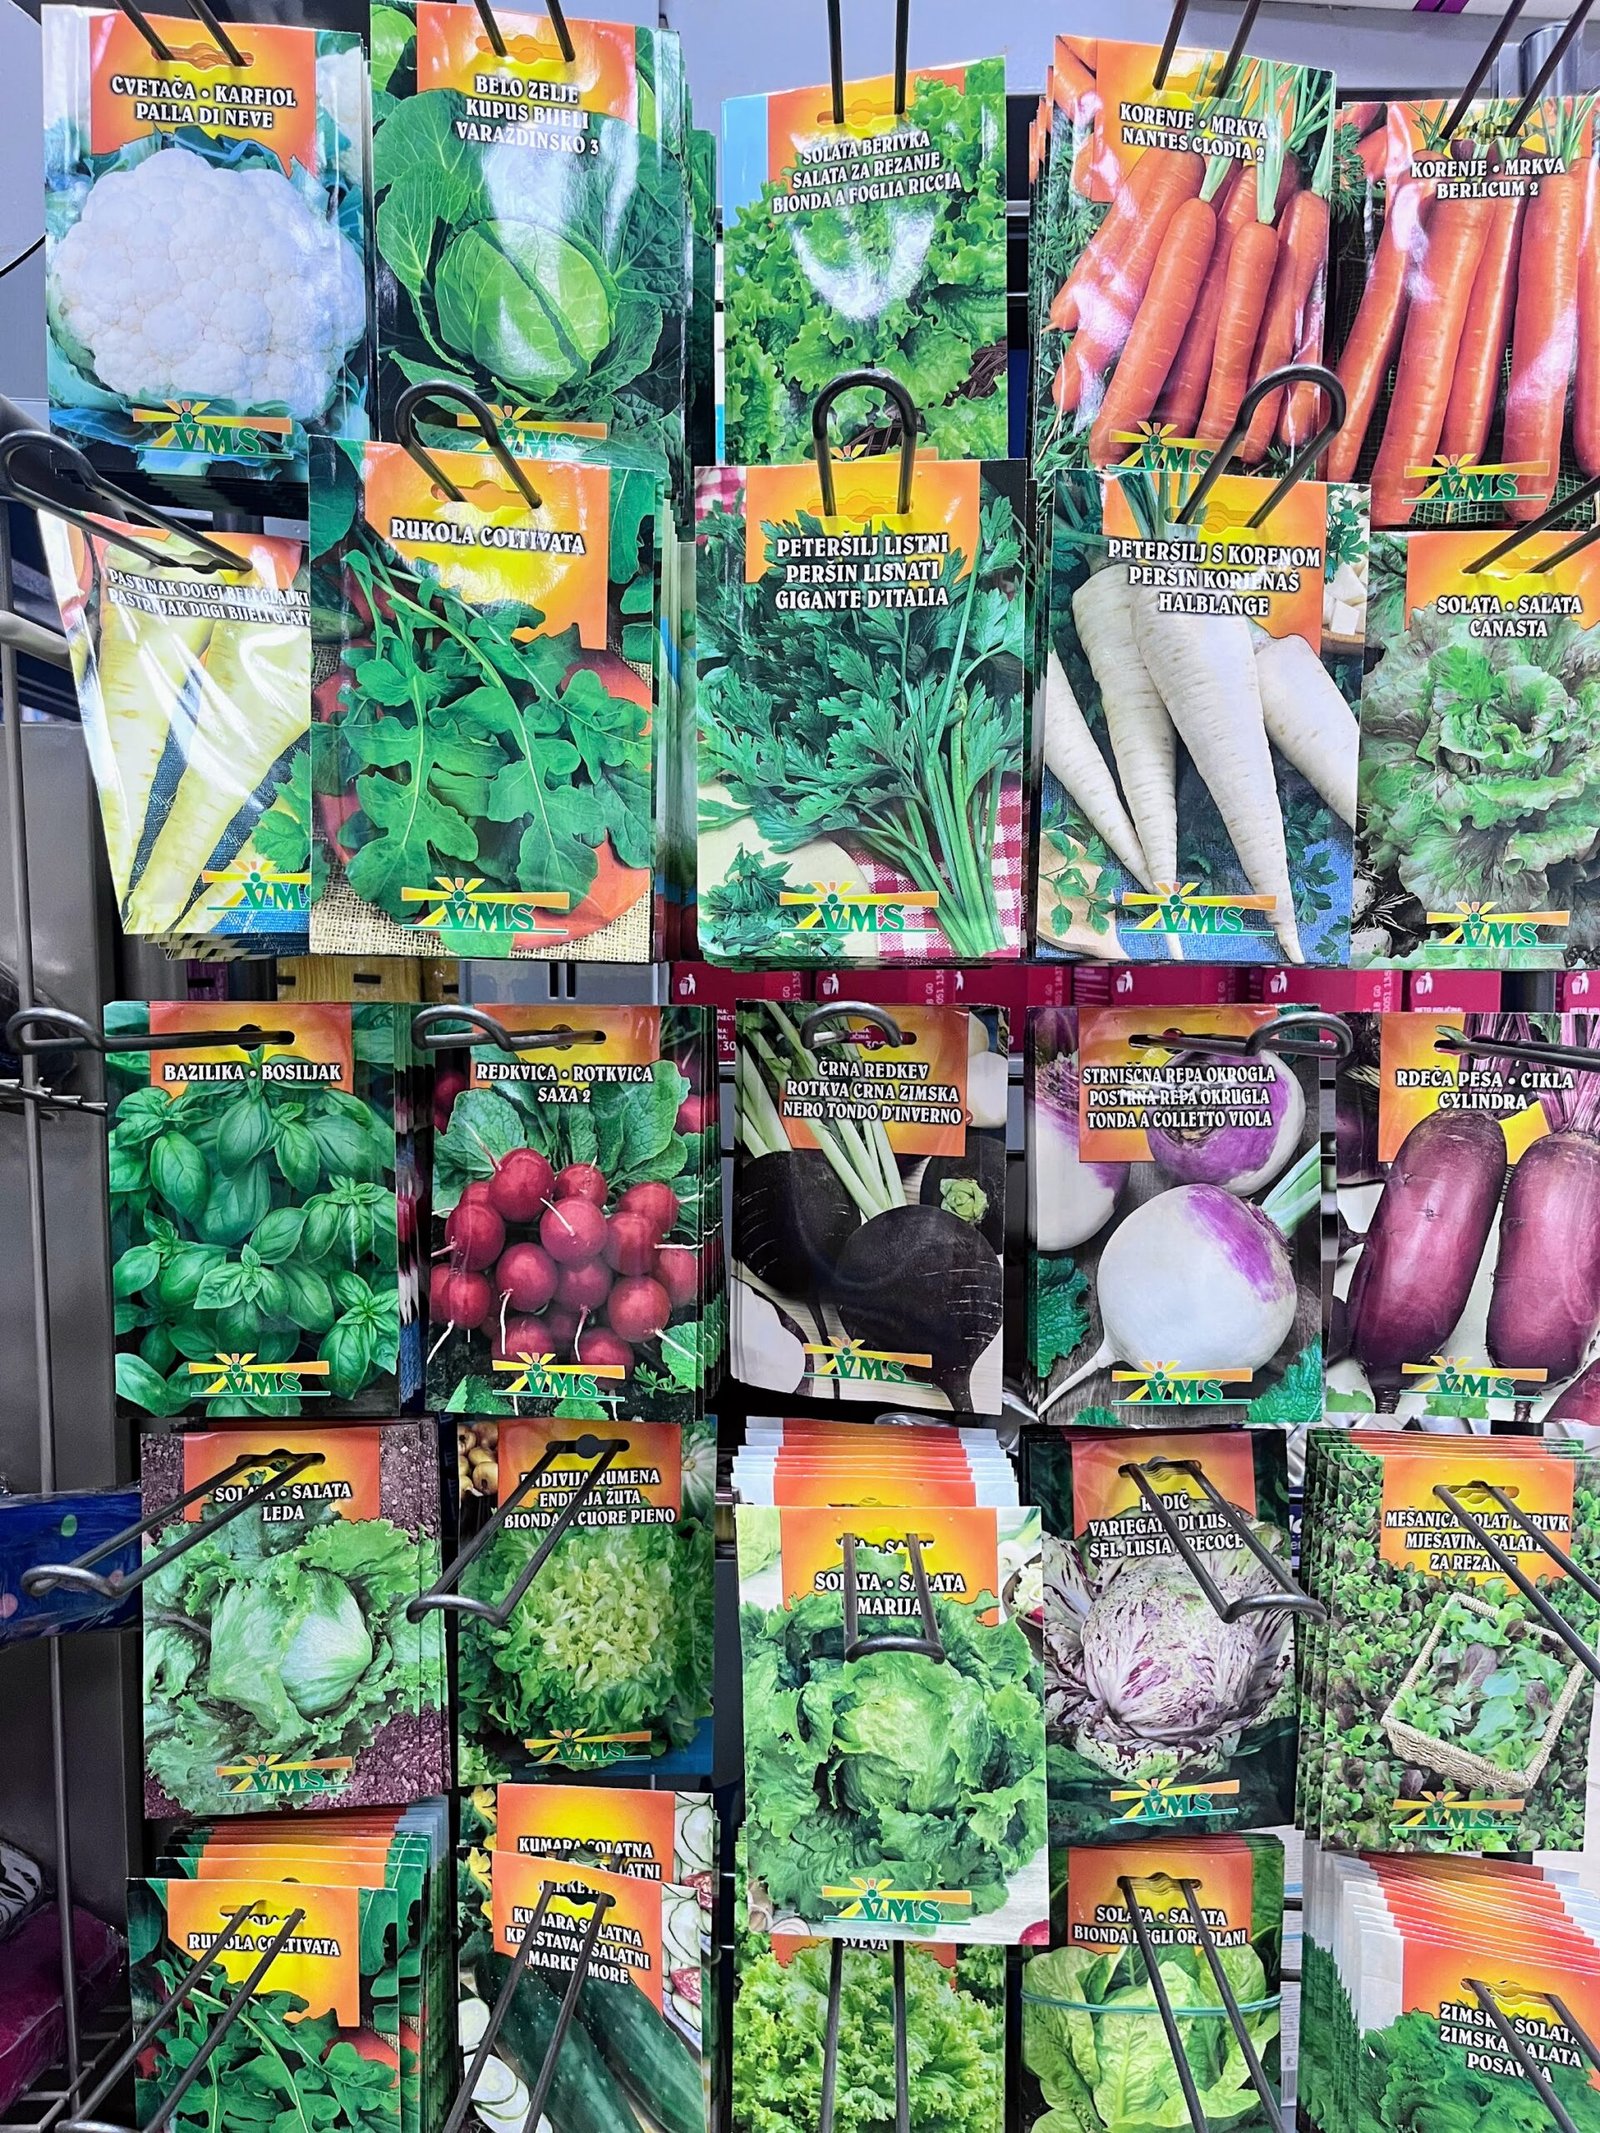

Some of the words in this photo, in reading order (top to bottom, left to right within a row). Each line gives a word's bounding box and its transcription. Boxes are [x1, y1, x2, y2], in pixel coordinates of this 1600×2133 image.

[111, 75, 196, 99] CVETAČA
[215, 84, 296, 107] KARFIOL
[476, 75, 523, 97] BELO
[528, 81, 579, 103] ZELJE
[136, 102, 194, 123] PALLA
[199, 108, 219, 124] DI
[225, 110, 273, 128] NEVE
[466, 99, 529, 122] KUPUS
[533, 107, 589, 129] BIJELI
[1120, 103, 1194, 129] KORENJE
[1211, 116, 1268, 139] MRKVA
[456, 122, 586, 153] VARAŽDINSKO
[590, 139, 599, 155] 3
[803, 142, 859, 165] SOLATA
[863, 131, 930, 156] BERIVKA
[1123, 128, 1188, 150] NANTES
[1192, 137, 1252, 159] CLODIA
[1257, 148, 1264, 161] 2
[793, 166, 848, 188] SALATA
[851, 164, 870, 179] ZA
[874, 152, 940, 176] REZANJE
[1411, 160, 1487, 178] KORENJE
[1505, 158, 1565, 176] MRKVA
[773, 193, 831, 214] BIONDA
[835, 192, 846, 205] A
[849, 183, 904, 204] FOGLIA
[909, 172, 962, 194] RICCIA
[1437, 181, 1525, 199] BERLICUM
[1530, 184, 1538, 196] 2
[172, 424, 260, 454] VMS
[1439, 473, 1518, 501] VMS
[391, 518, 475, 545] RUKOLA
[481, 527, 585, 553] COLTIVATA
[777, 532, 878, 557] PETERŠILJ
[884, 535, 948, 555] LISTNI
[1108, 537, 1206, 562] PETERŠILJ
[1212, 546, 1222, 563] S
[1228, 546, 1320, 567] KORENOM
[786, 561, 857, 583] PERŠIN
[864, 562, 939, 581] LISNATI
[1129, 562, 1197, 587] PERŠIN
[182, 581, 223, 601] DOLGI
[776, 590, 861, 609] GIGANTE
[868, 588, 949, 608] D'ITALIA
[190, 604, 226, 619] DUGI
[229, 607, 270, 623] BIJELI
[1159, 593, 1269, 616] HALBLANGE
[1437, 596, 1501, 614] SOLATA
[1518, 597, 1582, 614] SALATA
[1470, 620, 1548, 637] CANASTA
[445, 902, 535, 931] VMS
[825, 904, 903, 932] VMS
[1160, 903, 1245, 934] VMS
[1461, 922, 1540, 948] VMS
[164, 1064, 245, 1080] BAZILIKA
[262, 1064, 341, 1080] BOSILJAK
[477, 1064, 557, 1080] REDKVICA
[574, 1066, 653, 1082] ROTKVICA
[819, 1057, 860, 1077] ČRNA
[864, 1063, 929, 1079] REDKEV
[1083, 1064, 1164, 1084] STRNIŠČNA
[1167, 1068, 1203, 1083] REPA
[1207, 1067, 1275, 1083] OKROGLA
[1397, 1066, 1453, 1087] RDEČA
[1459, 1071, 1503, 1087] PESA
[1521, 1073, 1574, 1089] CIKLA
[538, 1087, 578, 1102] SAXA
[583, 1090, 591, 1102] 2
[787, 1081, 849, 1097] ROTKVA
[854, 1083, 894, 1099] CRNA
[900, 1085, 959, 1103] ZIMSKA
[1089, 1090, 1158, 1106] POSTRNA
[1161, 1090, 1198, 1105] REPA
[1201, 1089, 1270, 1105] OKRUGLA
[1439, 1093, 1528, 1109] CYLINDRA
[783, 1102, 823, 1117] NERO
[827, 1103, 878, 1120] TONDO
[882, 1106, 962, 1124] D'INVERNO
[1088, 1111, 1137, 1128] TONDA
[1140, 1112, 1149, 1128] A
[1153, 1111, 1225, 1127] COLLETTO
[1229, 1111, 1272, 1126] VIOLA
[836, 1356, 907, 1383] VMS
[225, 1372, 302, 1395] VMS
[525, 1372, 600, 1399] VMS
[1145, 1379, 1224, 1404] VMS
[1436, 1374, 1516, 1397] VMS
[599, 1470, 660, 1485] RUMENA
[292, 1483, 351, 1499] SALATA
[607, 1487, 641, 1504] ŽUTA
[263, 1506, 304, 1521] LEDA
[578, 1511, 627, 1525] CUORE
[631, 1509, 675, 1523] PIENO
[1179, 1516, 1194, 1529] DI
[1386, 1506, 1459, 1527] MEŠANICA
[1090, 1541, 1122, 1558] SEL.
[1126, 1538, 1171, 1555] LUSIA
[1431, 1555, 1449, 1569] ZA
[858, 1598, 922, 1615] MARIJA
[557, 1739, 625, 1760] VMS
[251, 1769, 326, 1791] VMS
[1142, 1793, 1214, 1817] VMS
[1425, 1808, 1496, 1829] VMS
[860, 1898, 941, 1922] VMS
[1074, 1926, 1129, 1943] BIONDA
[591, 1943, 650, 1969] SALATNI
[1441, 2025, 1509, 2053] ZIMSKA
